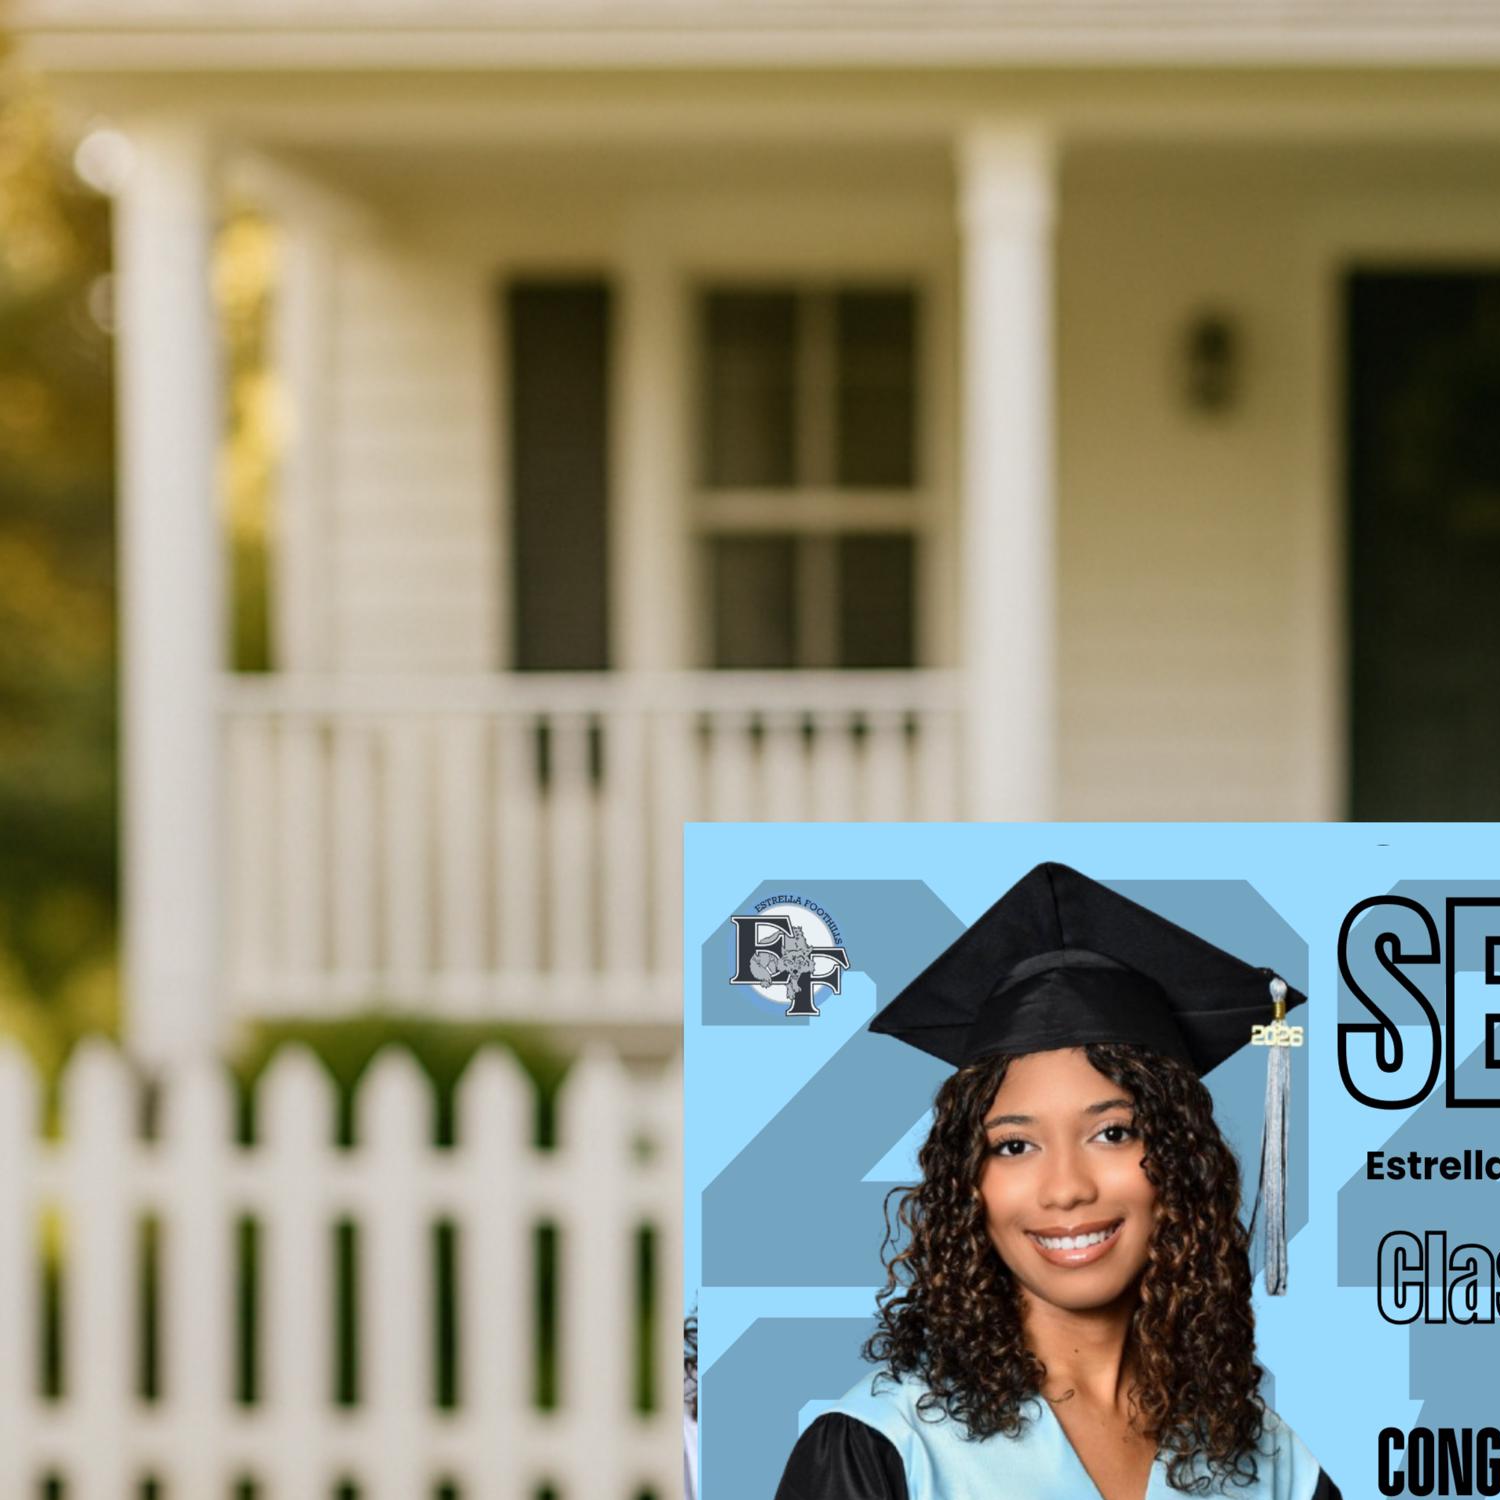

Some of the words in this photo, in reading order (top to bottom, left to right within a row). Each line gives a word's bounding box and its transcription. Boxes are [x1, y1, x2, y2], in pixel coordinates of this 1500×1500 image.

[754, 895, 802, 913] ESTRELLA
[804, 899, 843, 945] FOOTHILLS
[1251, 1024, 1304, 1047] 2026
